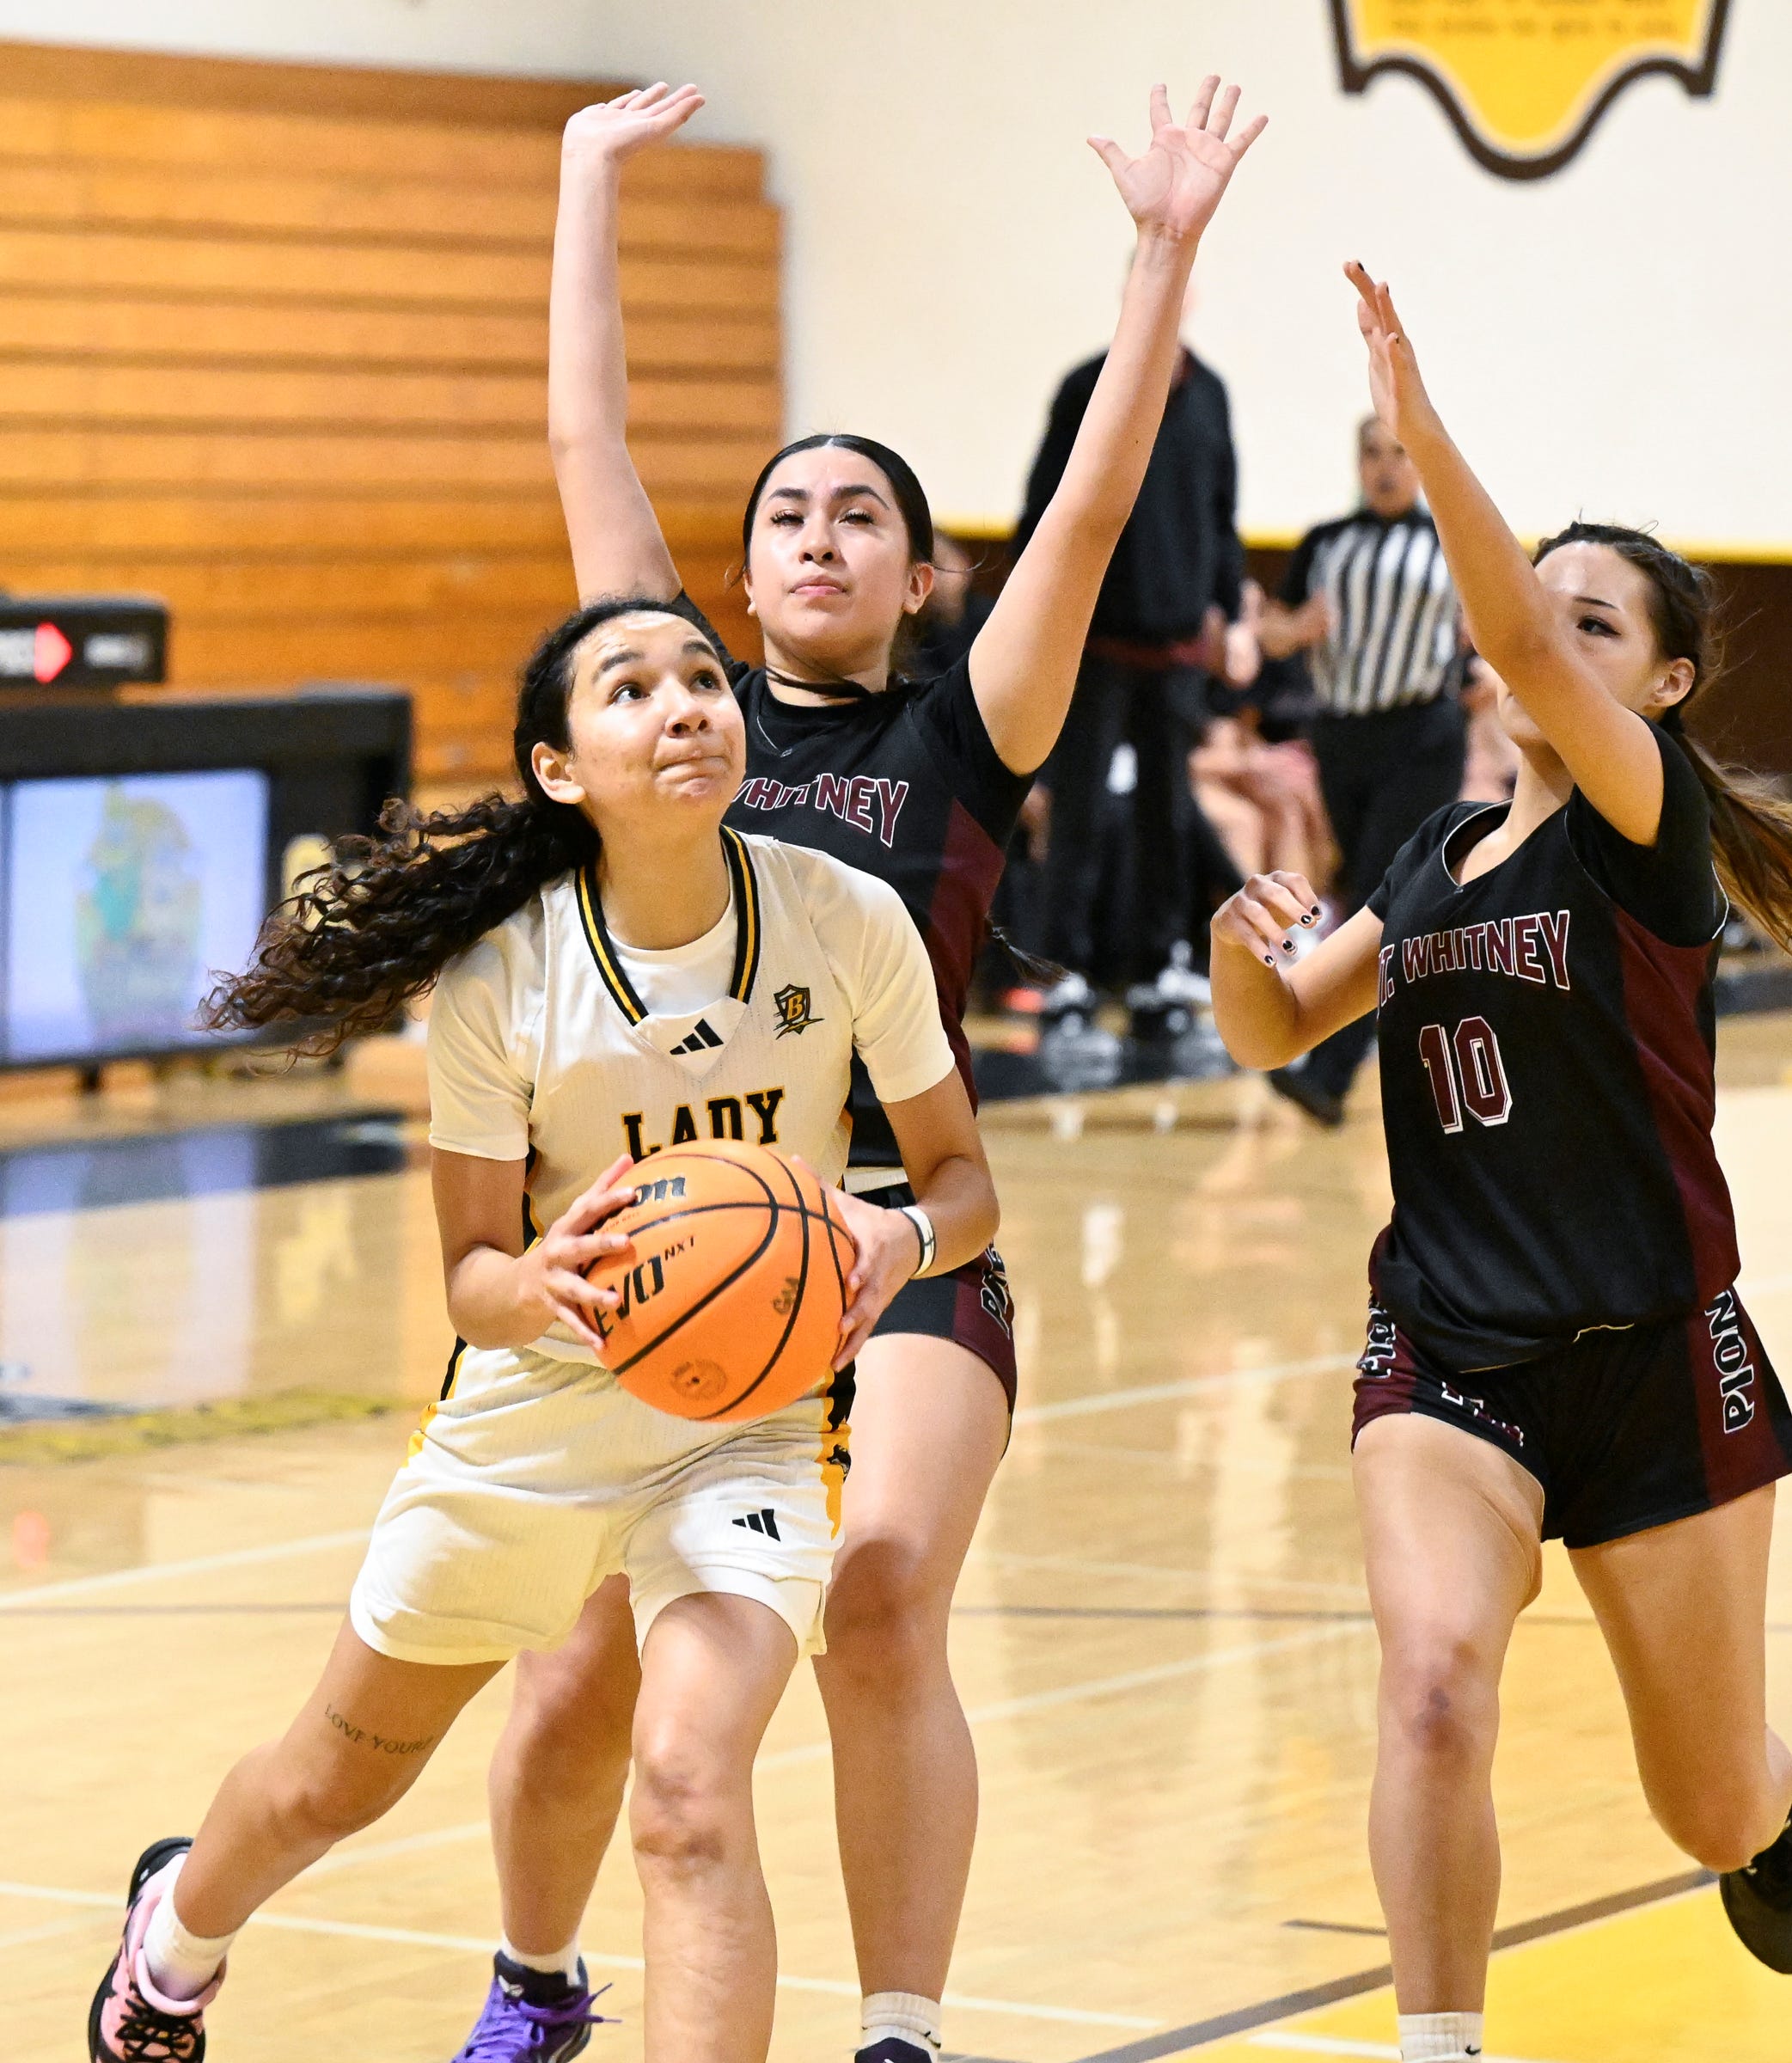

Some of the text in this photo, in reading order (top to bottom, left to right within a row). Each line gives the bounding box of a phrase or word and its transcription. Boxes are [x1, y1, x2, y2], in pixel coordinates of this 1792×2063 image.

[732, 774, 908, 848] HITNEY
[1377, 909, 1571, 1019] T. WHITNEY
[1419, 1015, 1513, 1135] 10
[621, 1086, 786, 1164] LADY
